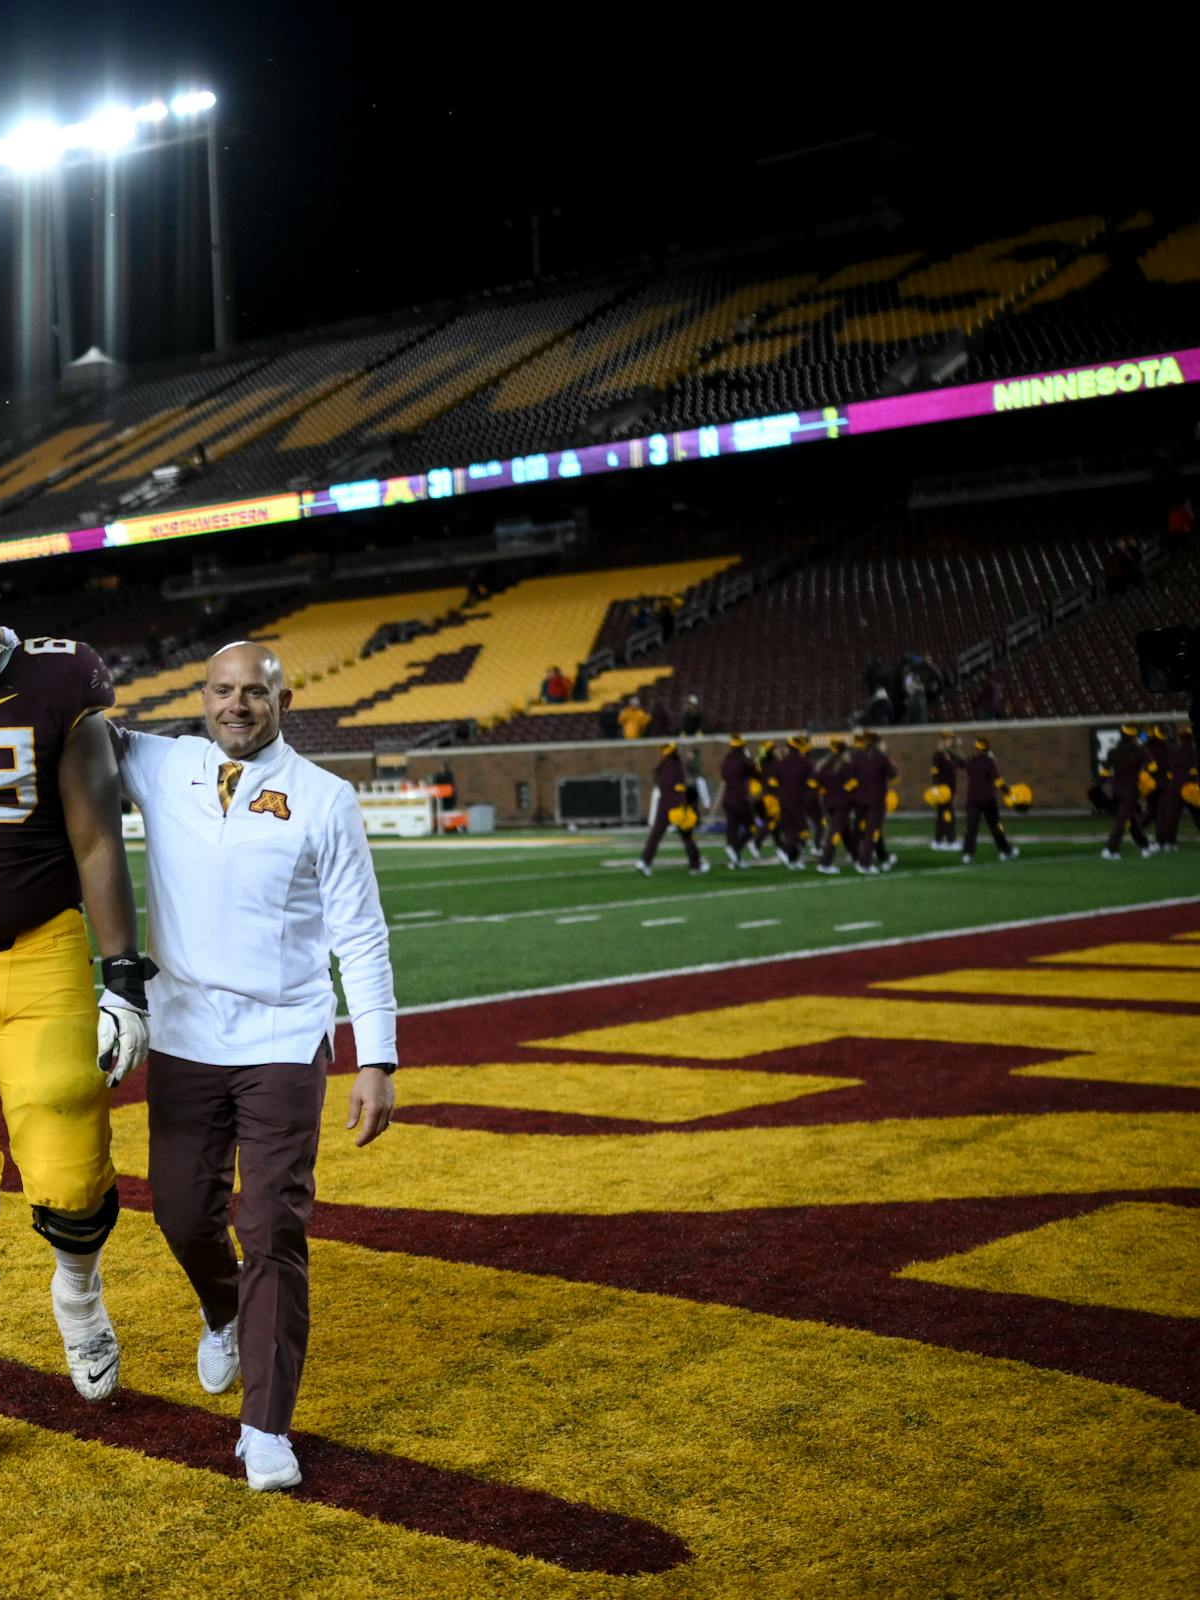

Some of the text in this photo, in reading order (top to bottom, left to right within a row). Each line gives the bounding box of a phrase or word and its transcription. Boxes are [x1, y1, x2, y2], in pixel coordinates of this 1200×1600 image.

[993, 356, 1185, 412] MINNESOTA
[149, 508, 269, 539] NORTHWESTERN
[249, 789, 291, 820] M
